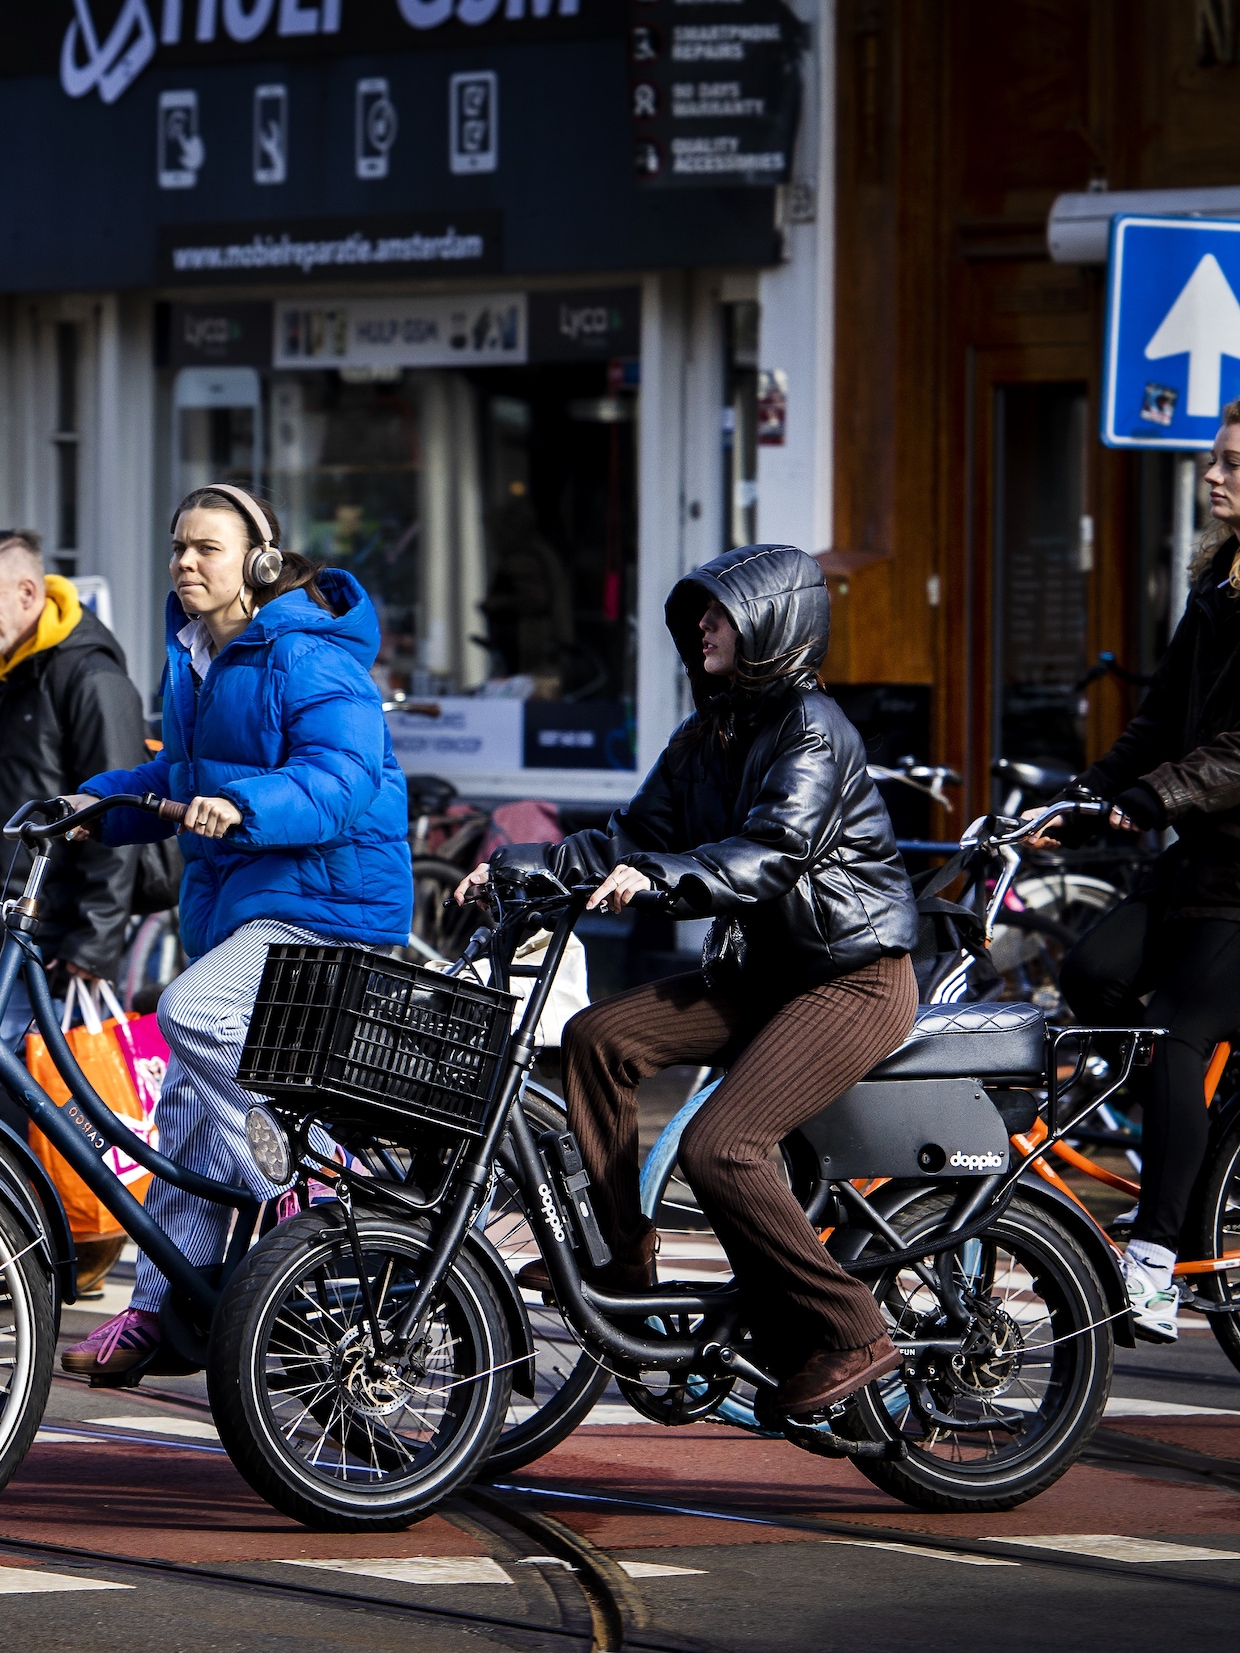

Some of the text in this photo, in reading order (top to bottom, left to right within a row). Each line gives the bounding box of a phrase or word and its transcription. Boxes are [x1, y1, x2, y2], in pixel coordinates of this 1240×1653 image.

[671, 23, 781, 42] SMARTPHONE
[671, 42, 745, 61] REPAIRS
[671, 98, 766, 118] WARRANTY
[671, 136, 740, 153] QUALITY
[672, 152, 786, 174] ACCESSORIES
[950, 1150, 1002, 1171] doppio
[538, 1183, 566, 1243] doppio
